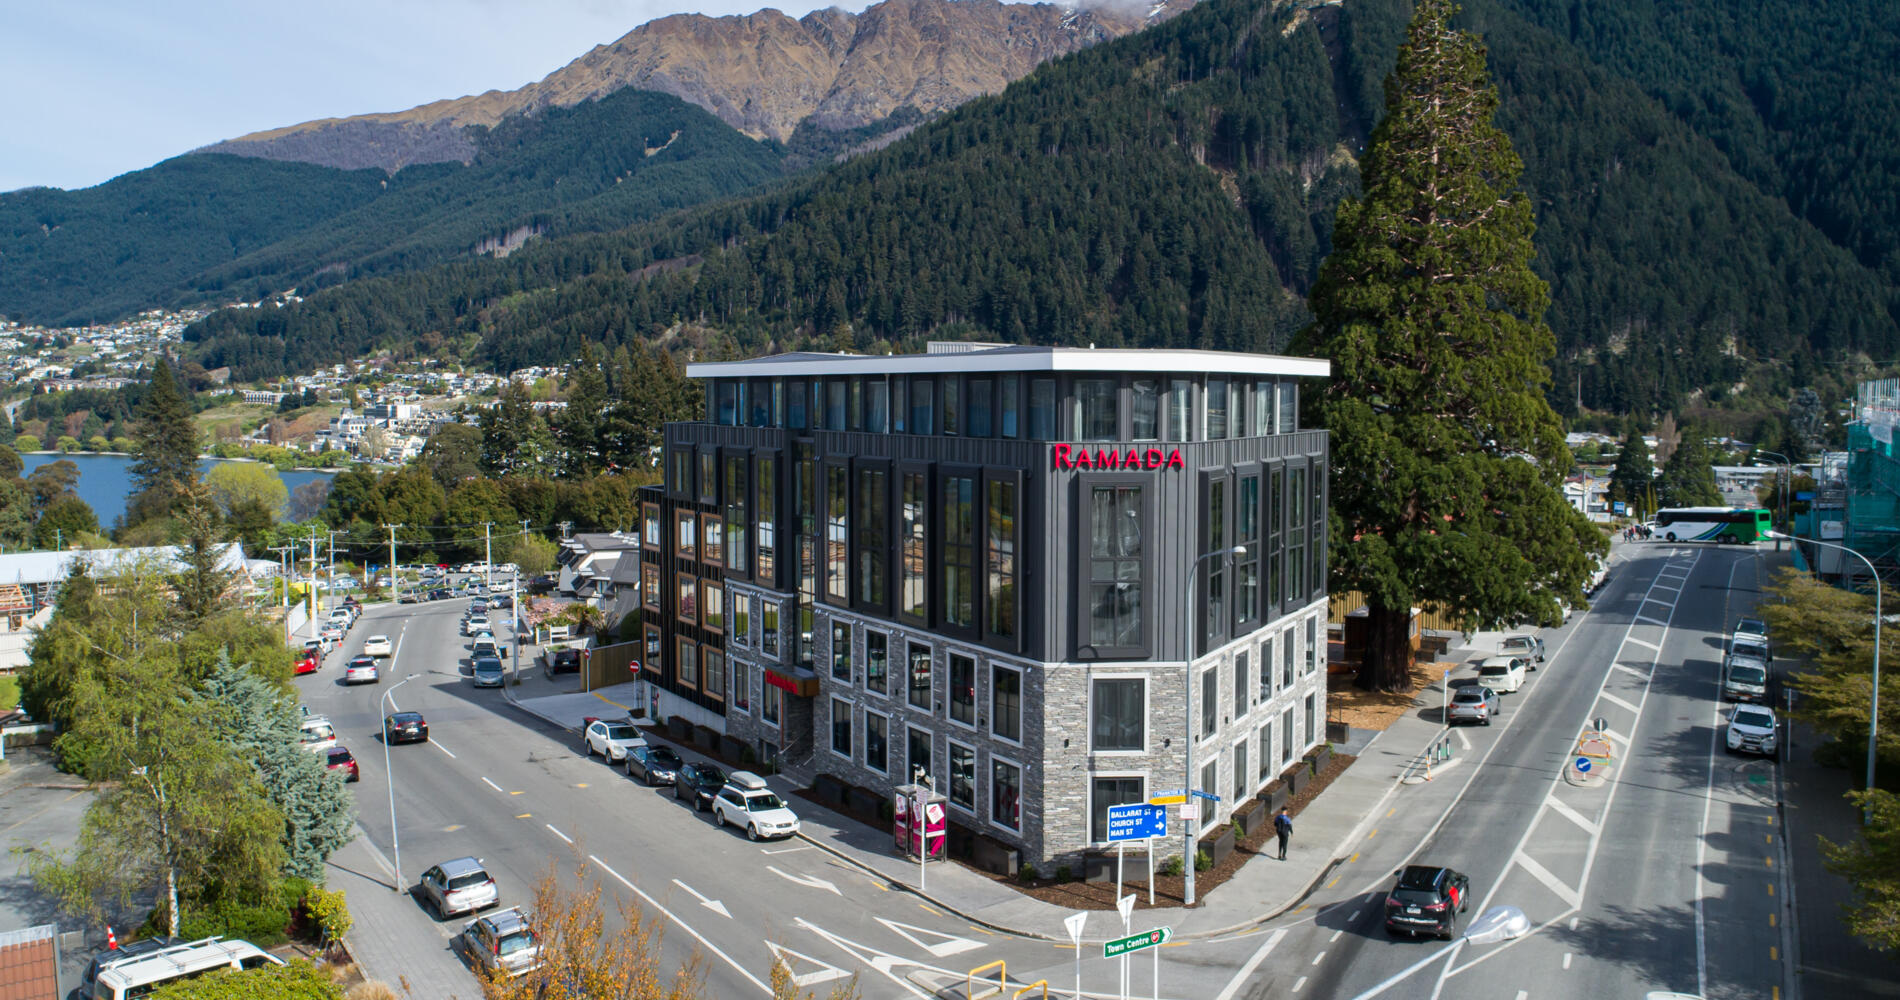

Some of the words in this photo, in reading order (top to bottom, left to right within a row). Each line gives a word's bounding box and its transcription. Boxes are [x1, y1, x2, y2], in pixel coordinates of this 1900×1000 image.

[1111, 809, 1142, 818] BALLARAT
[1107, 944, 1124, 953] Town
[1126, 937, 1149, 948] Centre
